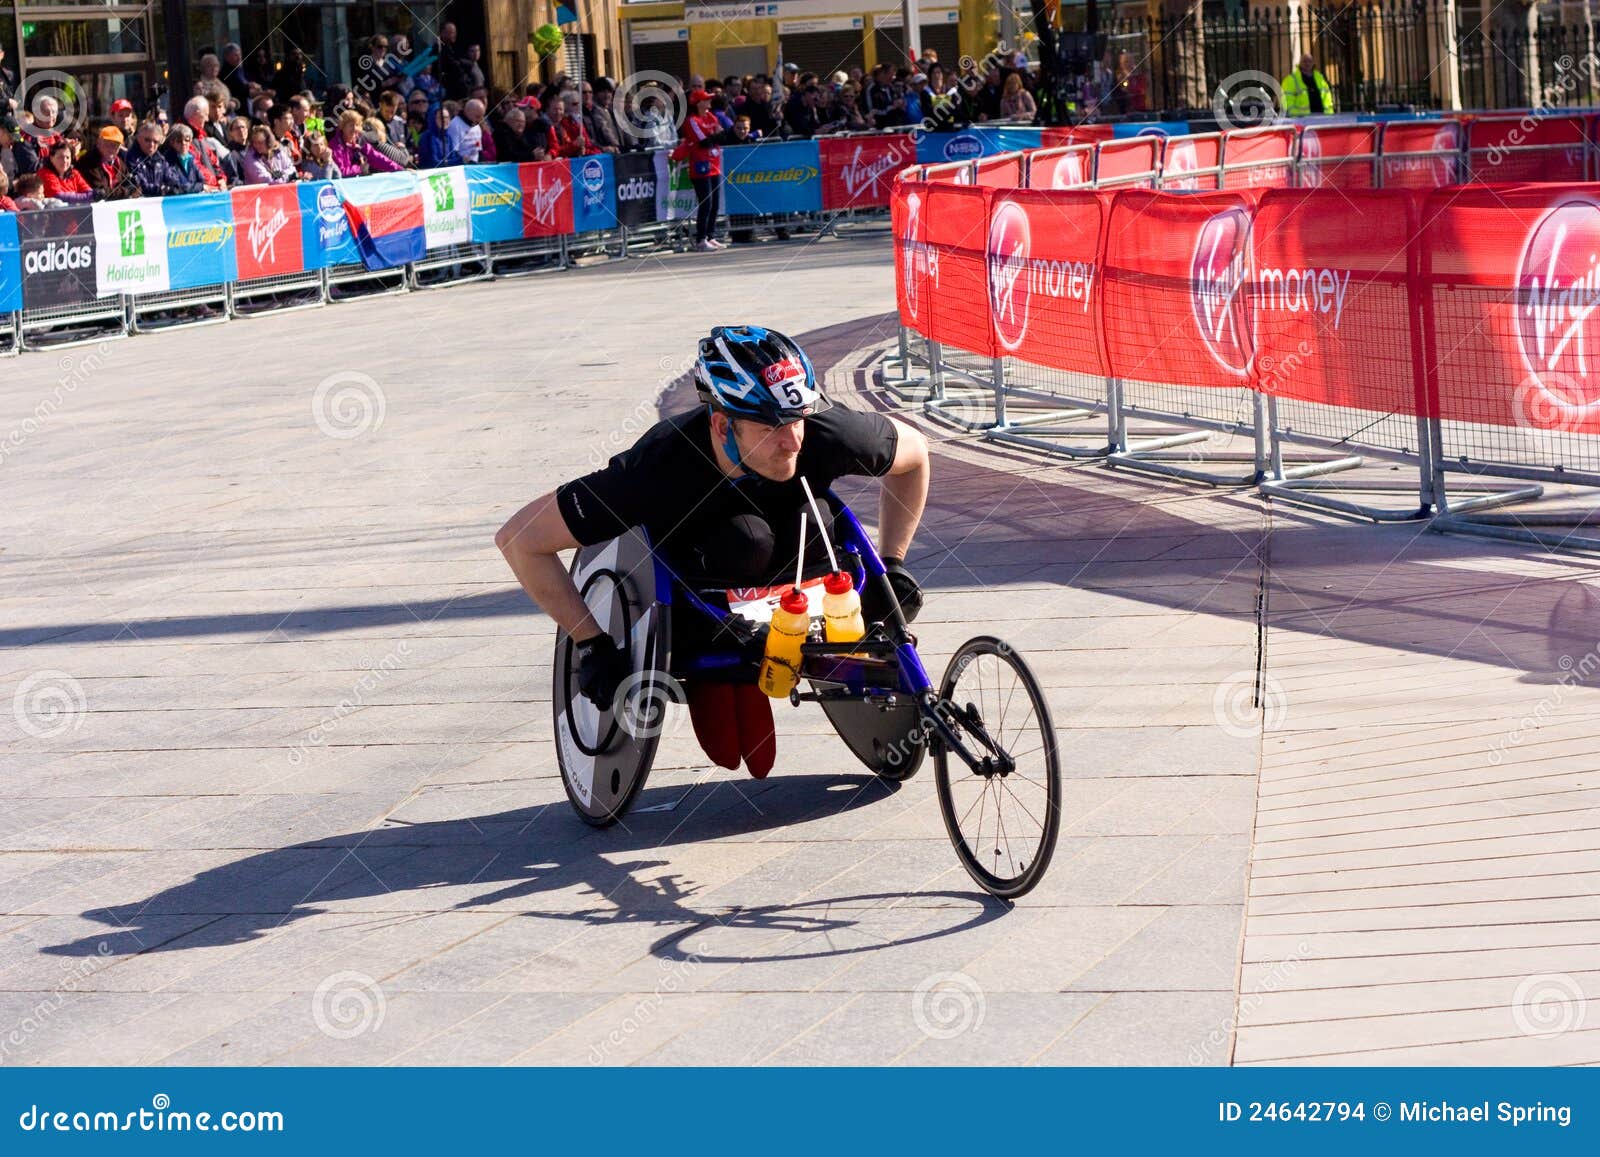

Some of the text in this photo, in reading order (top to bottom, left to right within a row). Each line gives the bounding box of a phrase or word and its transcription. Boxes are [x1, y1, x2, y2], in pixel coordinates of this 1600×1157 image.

[727, 167, 804, 185] Lucozade
[840, 145, 906, 198] Virgin
[533, 167, 565, 226] Virgin
[618, 177, 654, 200] adidas
[168, 225, 224, 249] Lucozade
[248, 197, 289, 264] Virgin
[25, 241, 91, 274] adidas
[106, 261, 161, 283] Holiday Inn
[1032, 258, 1096, 313] money
[1259, 265, 1351, 330] money
[781, 381, 803, 406] 5
